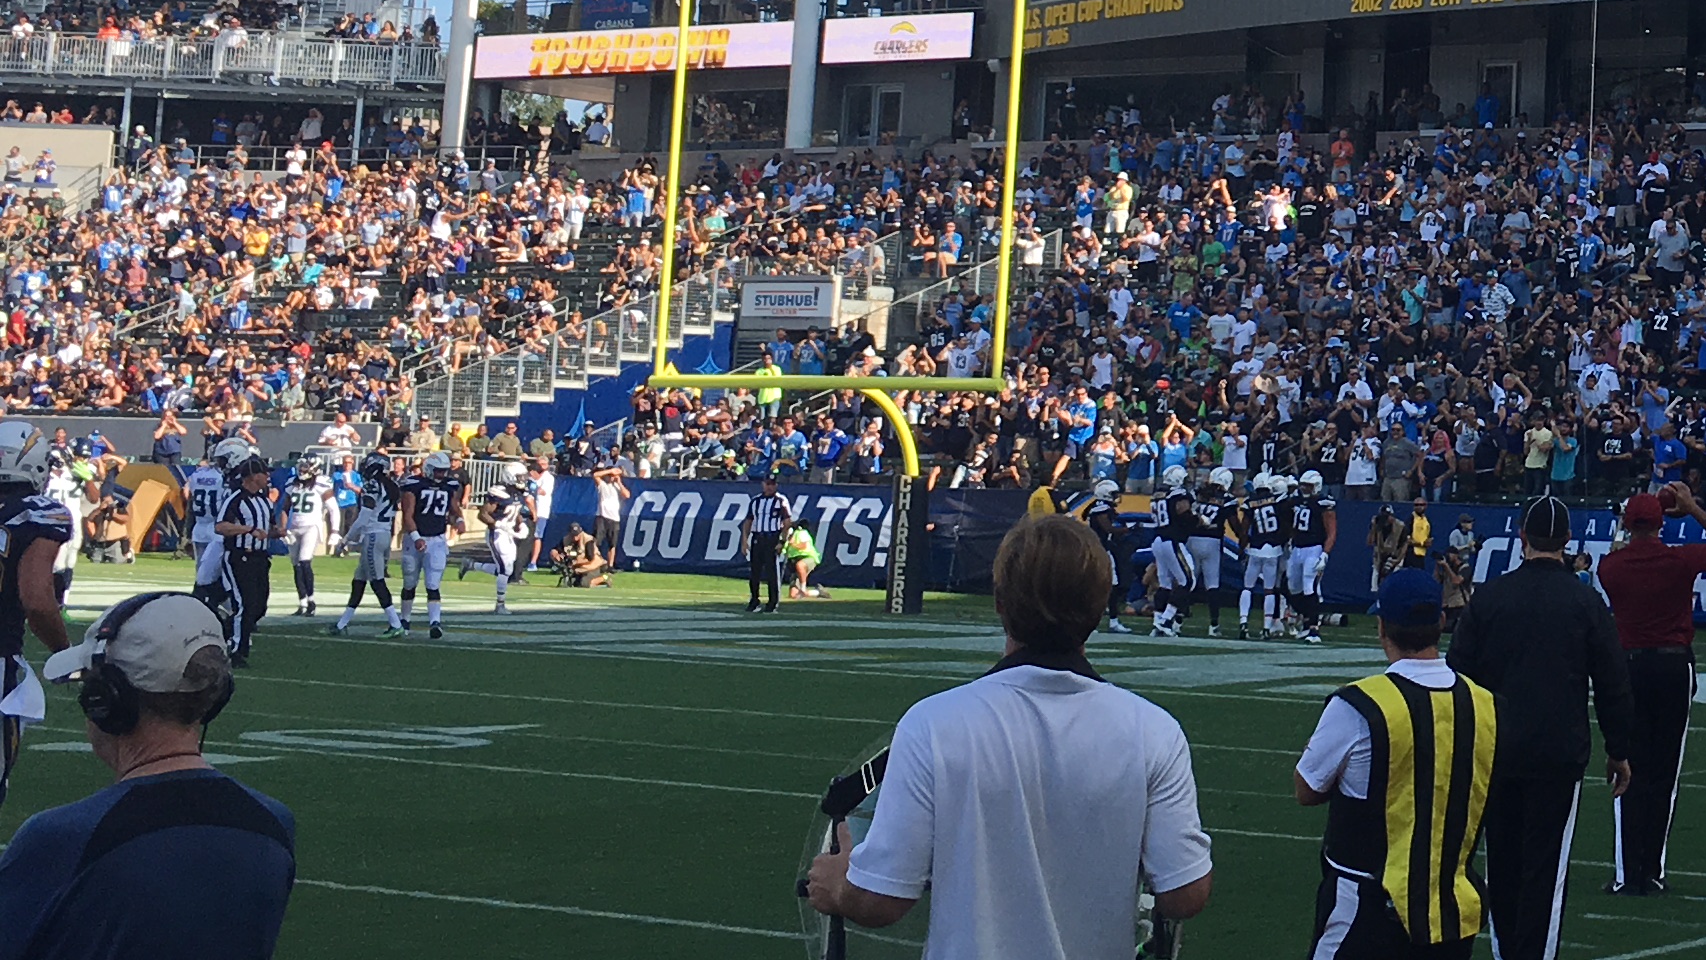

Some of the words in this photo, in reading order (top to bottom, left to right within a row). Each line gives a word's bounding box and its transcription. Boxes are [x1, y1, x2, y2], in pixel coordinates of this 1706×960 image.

[1045, 2, 1075, 27] OPEN
[529, 28, 730, 76] TOUCHDOWN
[754, 286, 820, 306] STUBHUB!
[1653, 315, 1669, 332] 22
[1263, 443, 1276, 461] 17
[1320, 447, 1337, 463] 22
[291, 492, 314, 513] 26
[421, 490, 448, 514] 73
[622, 490, 702, 560] GO
[705, 492, 893, 568] BTS!
[1254, 505, 1279, 533] 16
[890, 474, 912, 615] CHARGERS
